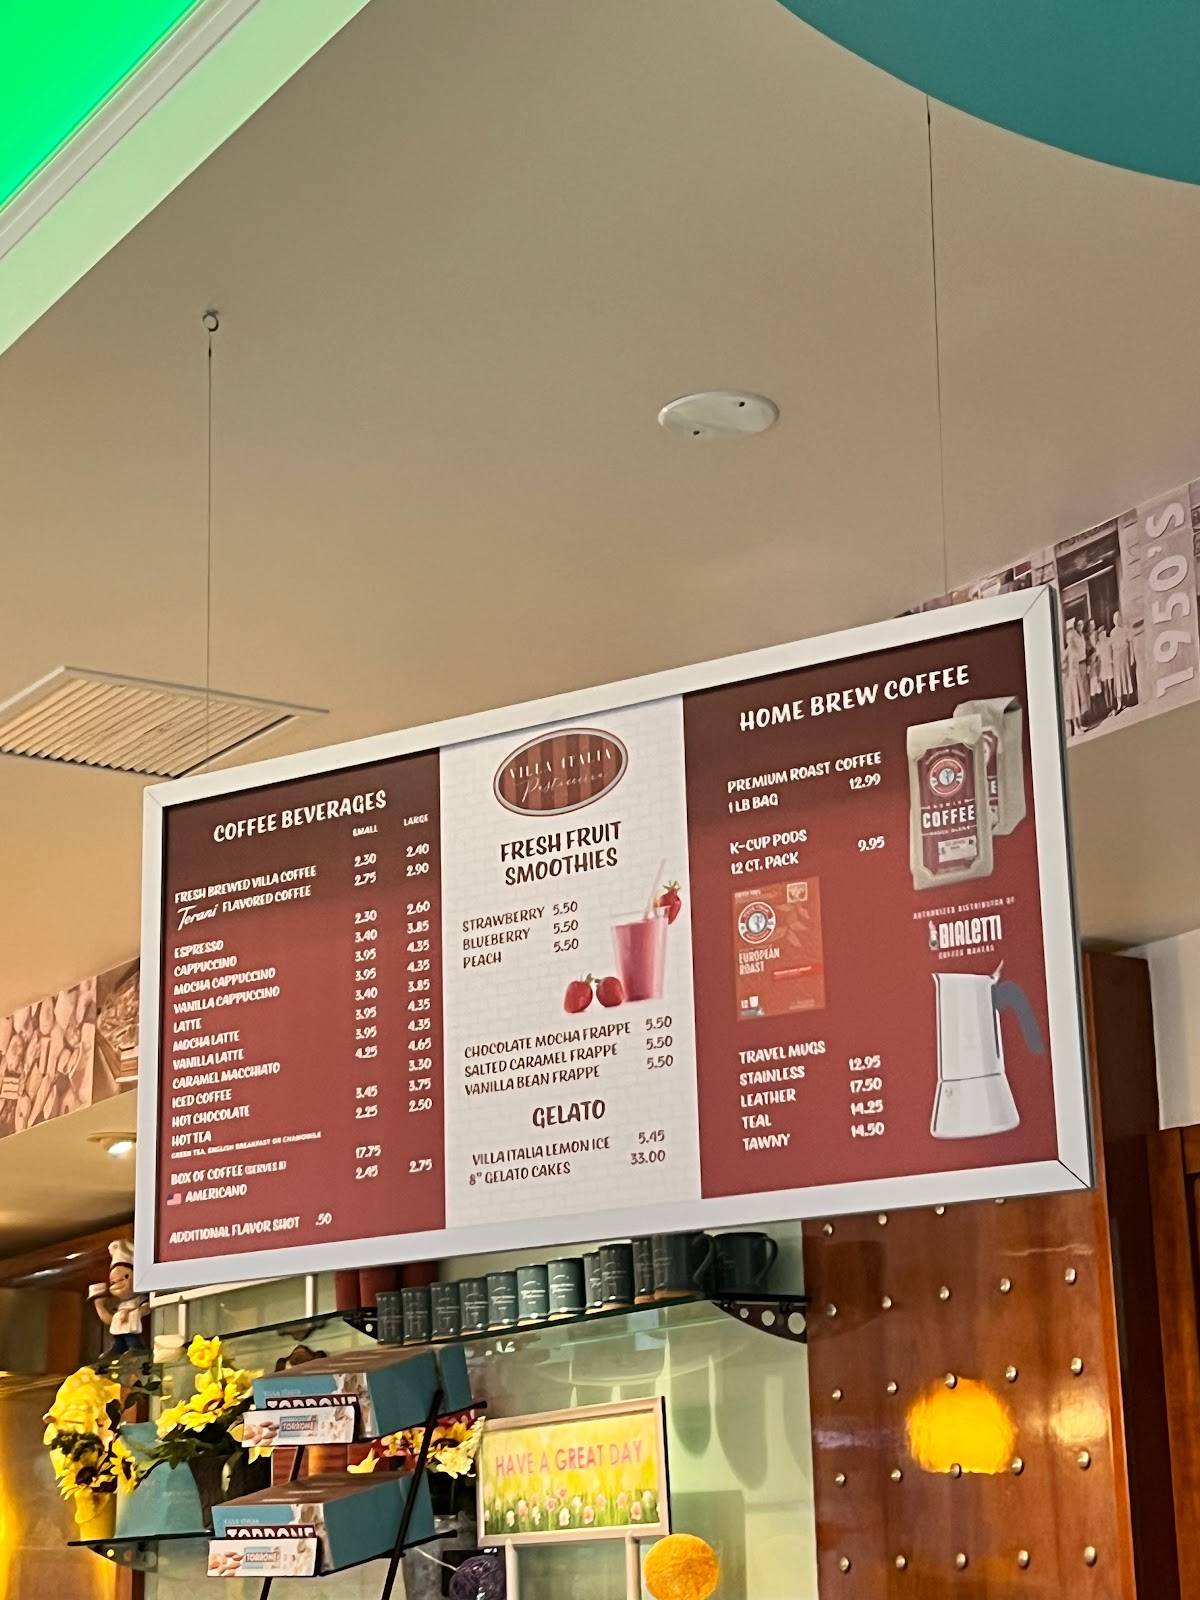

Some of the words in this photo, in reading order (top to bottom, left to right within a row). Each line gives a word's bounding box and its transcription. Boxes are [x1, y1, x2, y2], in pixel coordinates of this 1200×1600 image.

[1145, 502, 1195, 698] 1950'S
[740, 700, 805, 732] HOME
[810, 684, 879, 717] BREW
[884, 665, 970, 700] COFFEE
[727, 770, 788, 794] PREMIUM
[789, 761, 831, 781] ROAST
[835, 751, 882, 772] COFFEE
[735, 798, 751, 813] LB
[751, 793, 778, 809] BAG
[849, 773, 881, 790] 12.99
[213, 813, 277, 843] COFFEE
[281, 789, 387, 829] BEVERAGES
[403, 814, 429, 827] LARGE
[923, 804, 975, 829] COFFEE
[500, 833, 562, 862] FRESH
[567, 821, 622, 849] FRUIT
[729, 837, 772, 855] K-CUP
[772, 829, 807, 847] PODS
[857, 836, 885, 852] 9.95
[175, 888, 206, 904] FRESH
[208, 879, 250, 898] BREWED
[252, 873, 279, 888] VILLA
[280, 865, 316, 882] COFFEE
[354, 853, 376, 867] 2.30
[406, 843, 430, 858] 2.40
[505, 847, 618, 886] SMOOTHIES
[730, 862, 744, 875] 12
[745, 858, 763, 872] CT.
[765, 852, 799, 870] PACK
[222, 892, 273, 912] FLAVORED
[274, 885, 311, 902] COFFEE
[354, 871, 376, 886] 2.75
[406, 862, 430, 877] 2.90
[174, 940, 224, 959] ESPRESSO
[354, 909, 377, 924] 2.30
[406, 900, 431, 915] 2.60
[462, 907, 545, 933] STRAWBERRY
[553, 900, 578, 916] 5.50
[463, 928, 531, 950] BLUEBERRY
[553, 920, 579, 935] 5.50
[173, 956, 237, 977] CAPPUCCINO
[355, 929, 378, 943] 3.40
[407, 920, 430, 934] 3.85
[173, 978, 210, 995] MOCHA
[211, 967, 276, 989] CAPPUCCINO
[355, 948, 377, 963] 3.95
[407, 940, 430, 953] 4.35
[463, 952, 502, 969] PEACH
[553, 938, 579, 953] 5.50
[739, 948, 780, 964] EUROPEAN
[740, 961, 764, 975] ROAST
[173, 998, 215, 1015] VANILLA
[216, 986, 280, 1008] CAPPUCCINO
[355, 967, 377, 982] 3.95
[407, 959, 430, 973] 4.35
[173, 1018, 202, 1034] LATTE
[355, 987, 379, 1001] 3.40
[407, 979, 431, 993] 3.85
[173, 1035, 211, 1053] MOCHA
[210, 1030, 240, 1046] LATTE
[355, 1006, 377, 1021] 3.95
[407, 999, 431, 1012] 4.35
[173, 1054, 215, 1071] VANILLA
[215, 1049, 244, 1064] LATTE
[355, 1026, 377, 1040] 3.95
[408, 1018, 431, 1032] 4.35
[465, 1038, 532, 1059] CHOCOLATE
[535, 1029, 581, 1048] MOCHA
[583, 1022, 631, 1041] FRAPPE
[645, 1016, 672, 1031] 5.50
[172, 1071, 221, 1090] CARAMEL
[221, 1062, 281, 1082] MACCHIATO
[355, 1046, 378, 1059] 4.25
[408, 1038, 432, 1052] 4.65
[465, 1060, 507, 1078] SALTED
[509, 1051, 567, 1071] CARAMEL
[570, 1043, 618, 1062] FRAPPE
[646, 1035, 673, 1051] 5.50
[739, 1047, 788, 1065] TRAVEL
[788, 1040, 826, 1057] MUGS
[739, 1065, 806, 1087] STAINLESS
[849, 1055, 881, 1071] 12.95
[172, 1094, 195, 1109] ICED
[195, 1088, 232, 1104] COFFEE
[408, 1058, 432, 1072] 3.30
[465, 1078, 514, 1096] VANILLA
[517, 1072, 550, 1090] BEAN
[552, 1065, 601, 1083] FRAPPE
[646, 1055, 674, 1070] 5.50
[740, 1088, 797, 1108] LEATHER
[850, 1077, 883, 1094] 17.50
[171, 1134, 191, 1147] HOT
[191, 1131, 212, 1143] TEA
[355, 1105, 379, 1119] 2.25
[408, 1099, 433, 1113] 2.50
[172, 1113, 193, 1128] HOT
[193, 1105, 251, 1124] CHOCOLATE
[355, 1085, 379, 1100] 3.45
[408, 1078, 432, 1092] 3.75
[532, 1099, 606, 1128] GELATO
[741, 1113, 772, 1130] TEAL
[850, 1099, 883, 1116] 14.25
[472, 1151, 508, 1166] VILLA
[508, 1145, 544, 1162] ITALIA
[545, 1140, 590, 1156] LEMON
[591, 1136, 611, 1151] ICE
[638, 1130, 665, 1145] 5.45
[743, 1133, 791, 1152] TAWNY
[851, 1122, 884, 1138] 14.50
[171, 1172, 192, 1186] BOX
[193, 1170, 206, 1183] OF
[207, 1165, 244, 1181] COFFEE
[355, 1145, 382, 1159] 17.75
[185, 1184, 248, 1203] AMERICANO
[355, 1165, 379, 1180] 2.45
[409, 1159, 433, 1173] 2.75
[484, 1165, 529, 1184] GELATO
[532, 1162, 571, 1178] CAKES
[630, 1149, 666, 1165] 33.00
[169, 1225, 231, 1244] ADDITIONAL
[231, 1220, 272, 1237] FLAVOR
[272, 1216, 300, 1232] SHOT
[315, 1213, 332, 1226] .50
[496, 1452, 534, 1477] HAVE
[539, 1451, 550, 1471] A
[555, 1445, 604, 1471] GREAT
[609, 1440, 644, 1465] DAY
